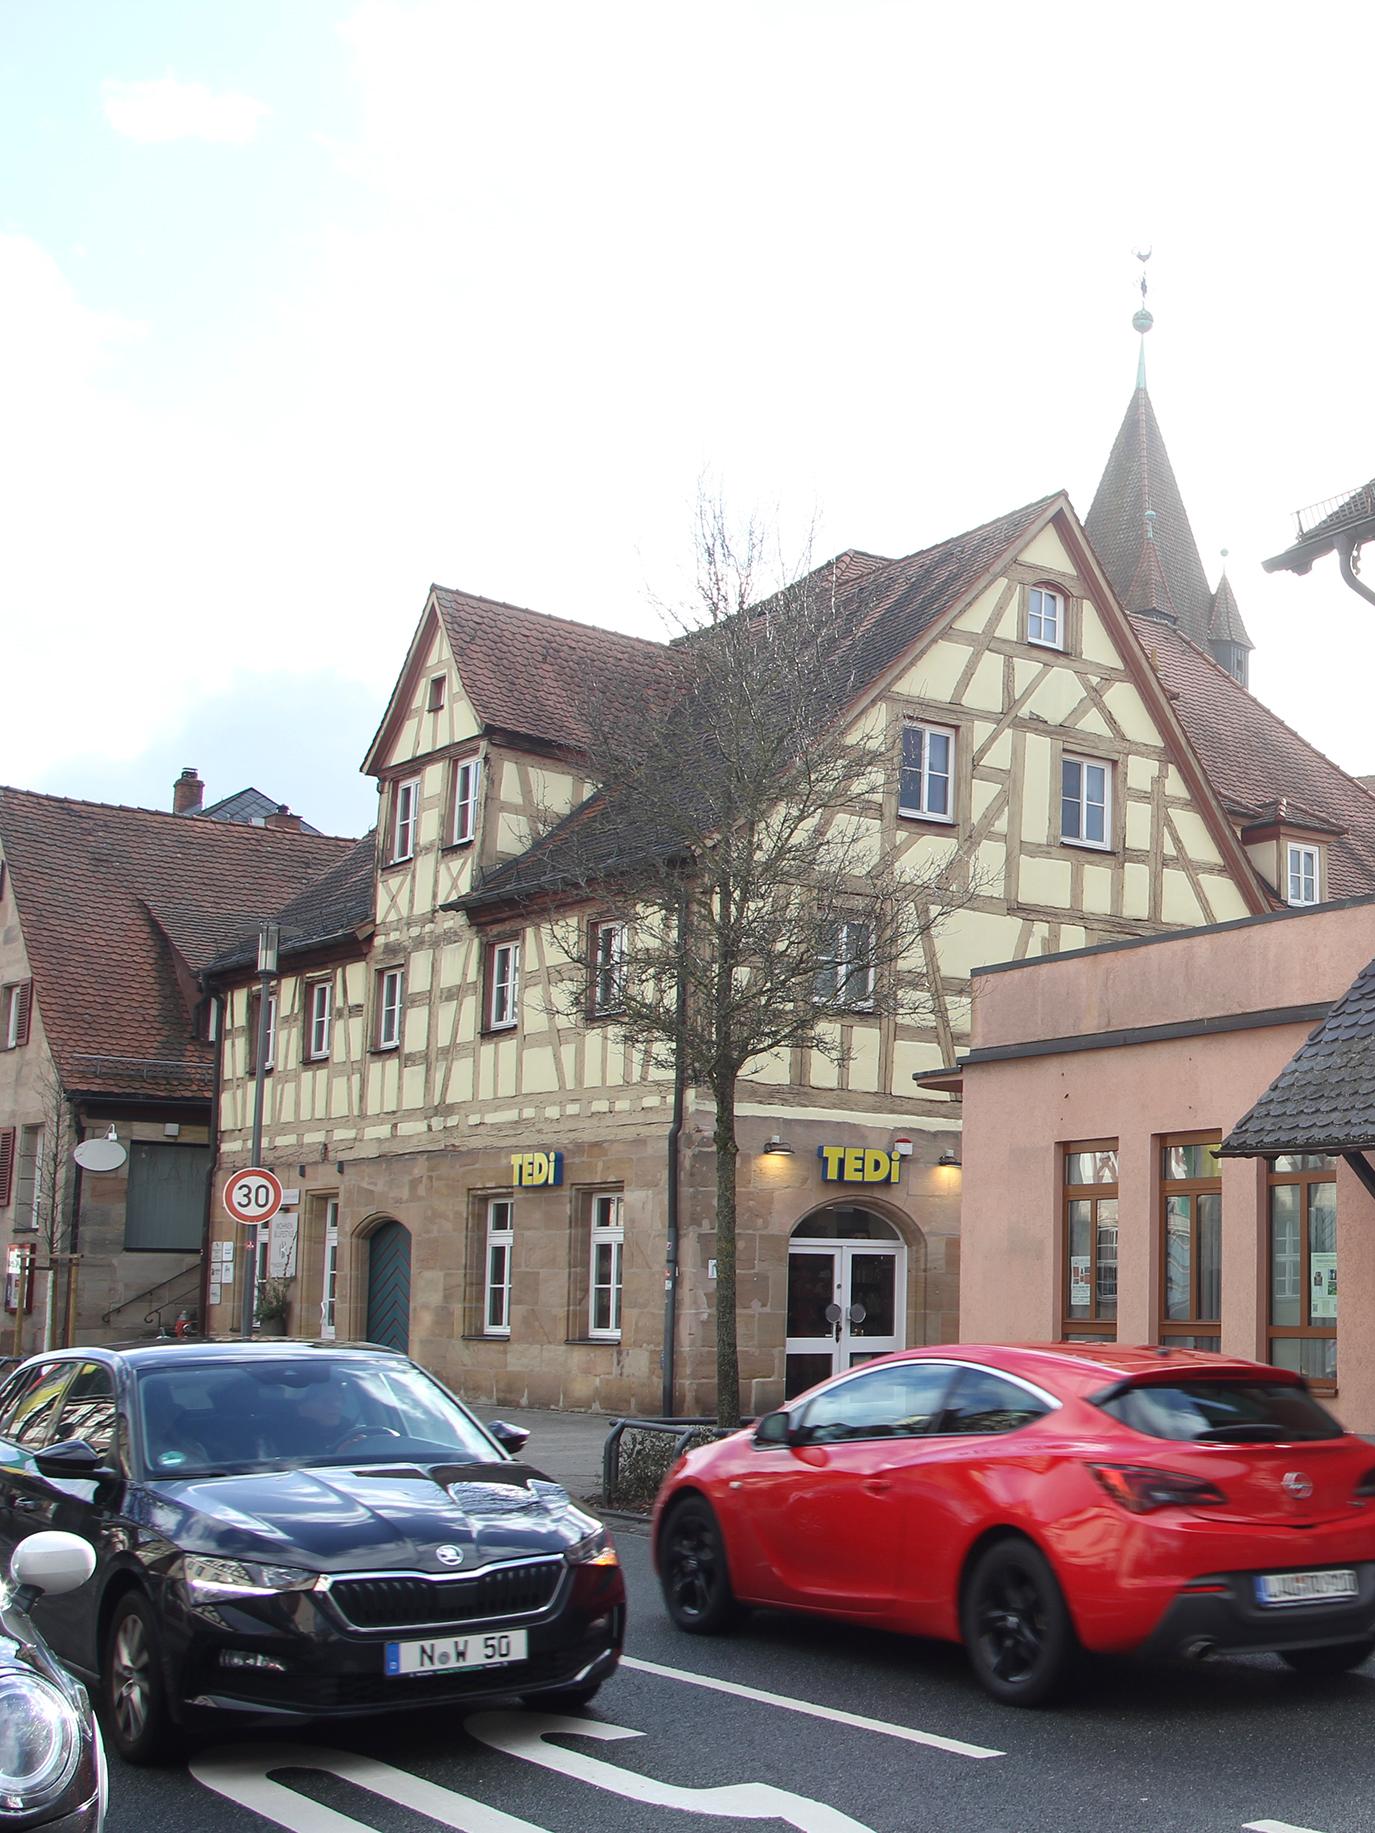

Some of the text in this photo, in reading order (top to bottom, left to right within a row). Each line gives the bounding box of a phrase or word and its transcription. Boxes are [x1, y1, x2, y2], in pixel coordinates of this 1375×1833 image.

[511, 1151, 555, 1186] TEDi
[823, 1146, 901, 1183] TEDi
[237, 1184, 270, 1208] 30
[420, 1643, 435, 1667] N
[454, 1639, 469, 1663] W
[484, 1635, 511, 1660] 50
